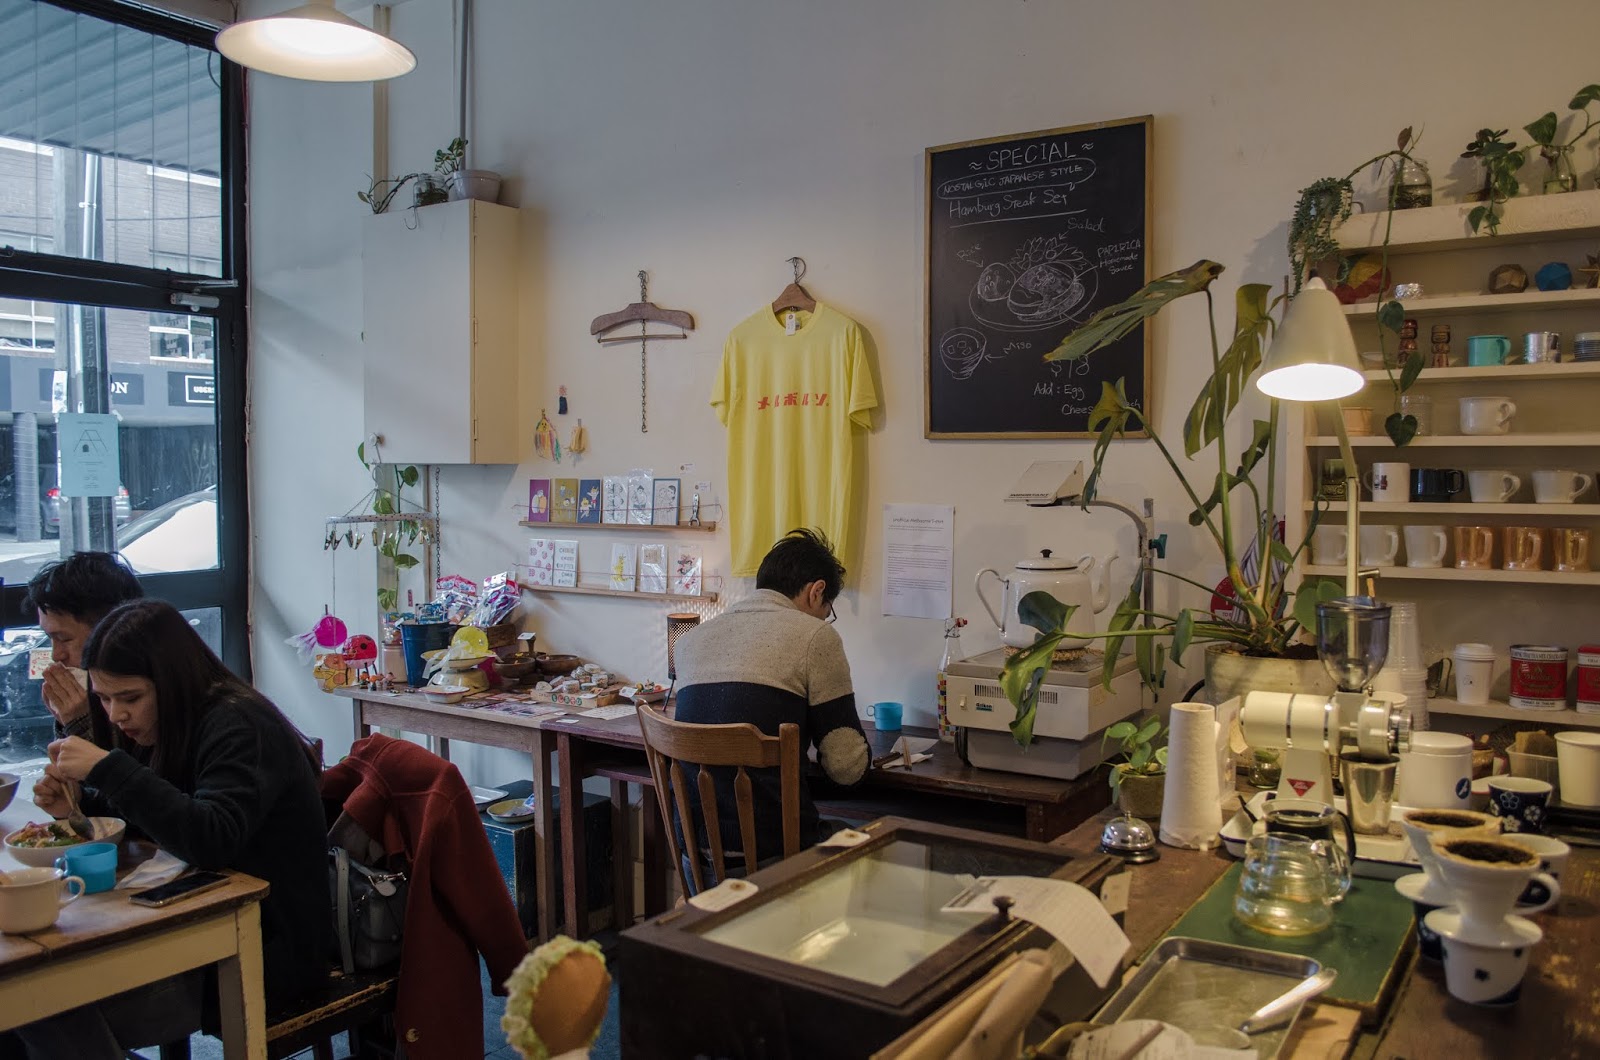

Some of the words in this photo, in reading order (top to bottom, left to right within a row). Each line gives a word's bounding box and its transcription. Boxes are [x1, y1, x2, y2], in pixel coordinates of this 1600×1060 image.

[986, 142, 1076, 170] SPECIAL
[998, 171, 1044, 187] JAPANESE
[1050, 165, 1083, 177] STYLE
[950, 197, 1001, 218] Hamburg
[1003, 192, 1036, 210] Steak
[1043, 189, 1068, 205] Set
[1067, 217, 1105, 232] Salad
[1064, 384, 1085, 400] Egg
[1062, 404, 1094, 415] Chees
